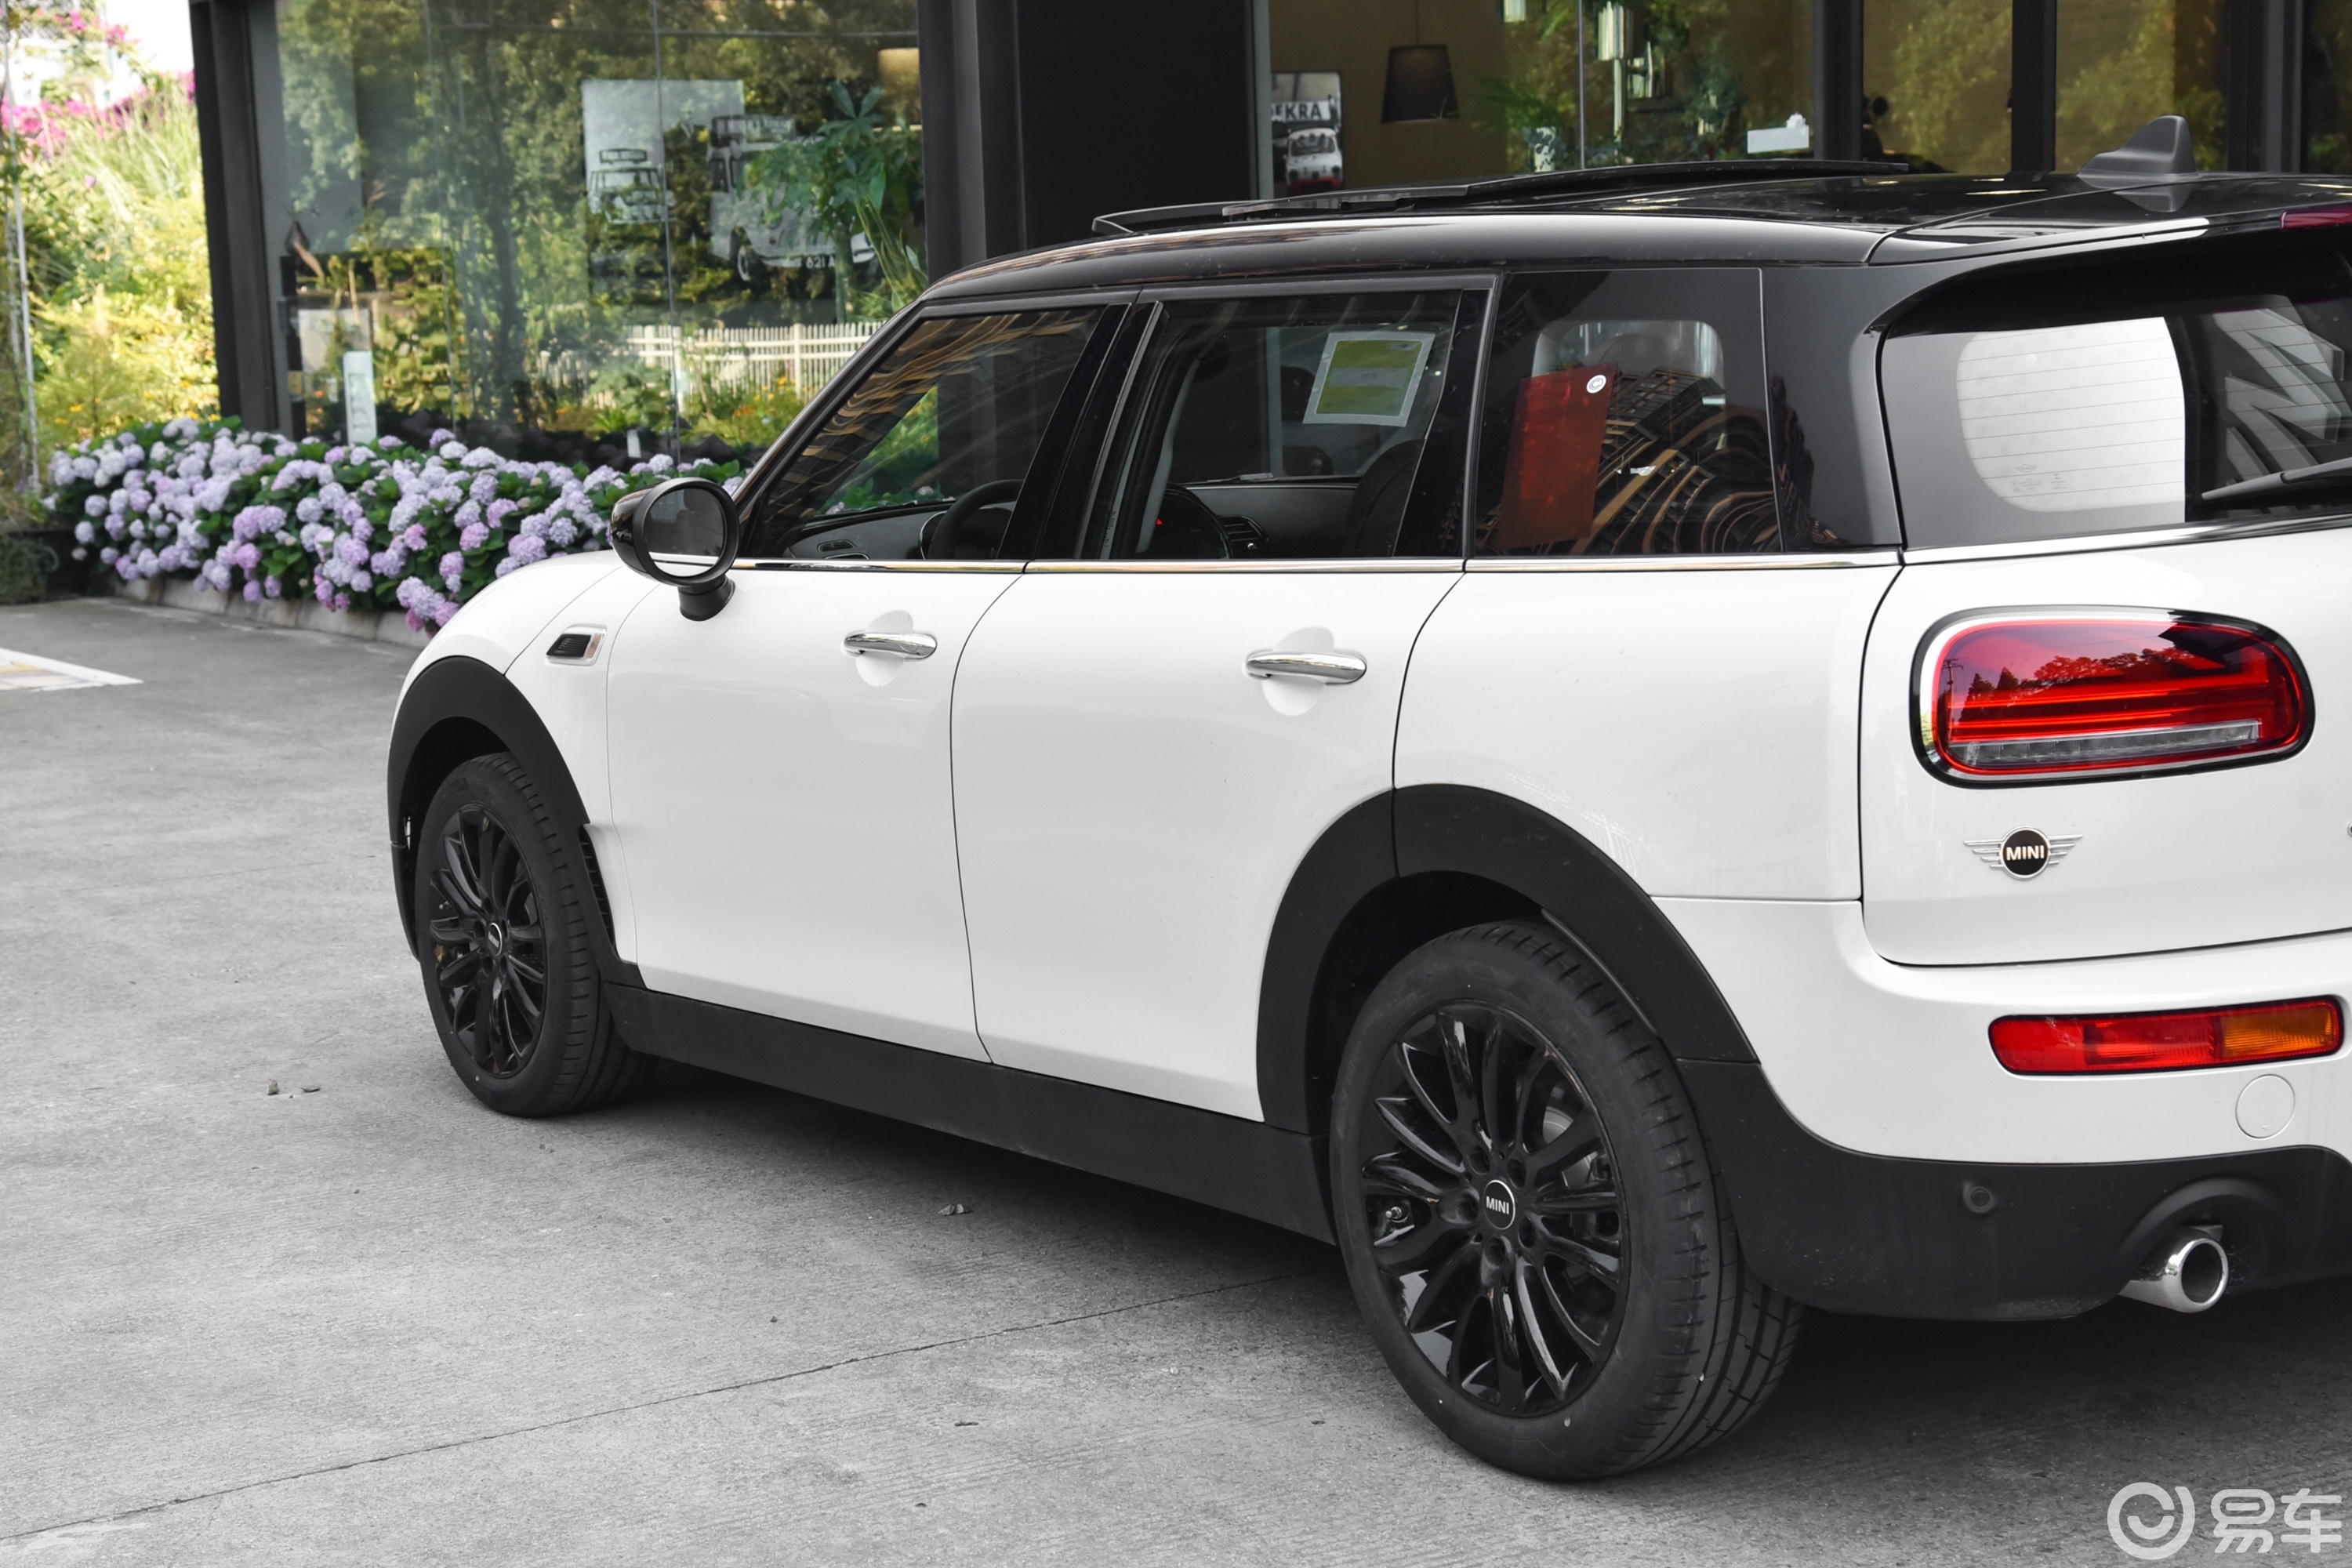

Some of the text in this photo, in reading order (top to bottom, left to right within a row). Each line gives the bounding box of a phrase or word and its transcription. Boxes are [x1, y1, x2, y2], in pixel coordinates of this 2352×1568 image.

[1271, 103, 1322, 120] EKRA
[2005, 844, 2045, 862] MINI
[1486, 1196, 1509, 1214] MINI
